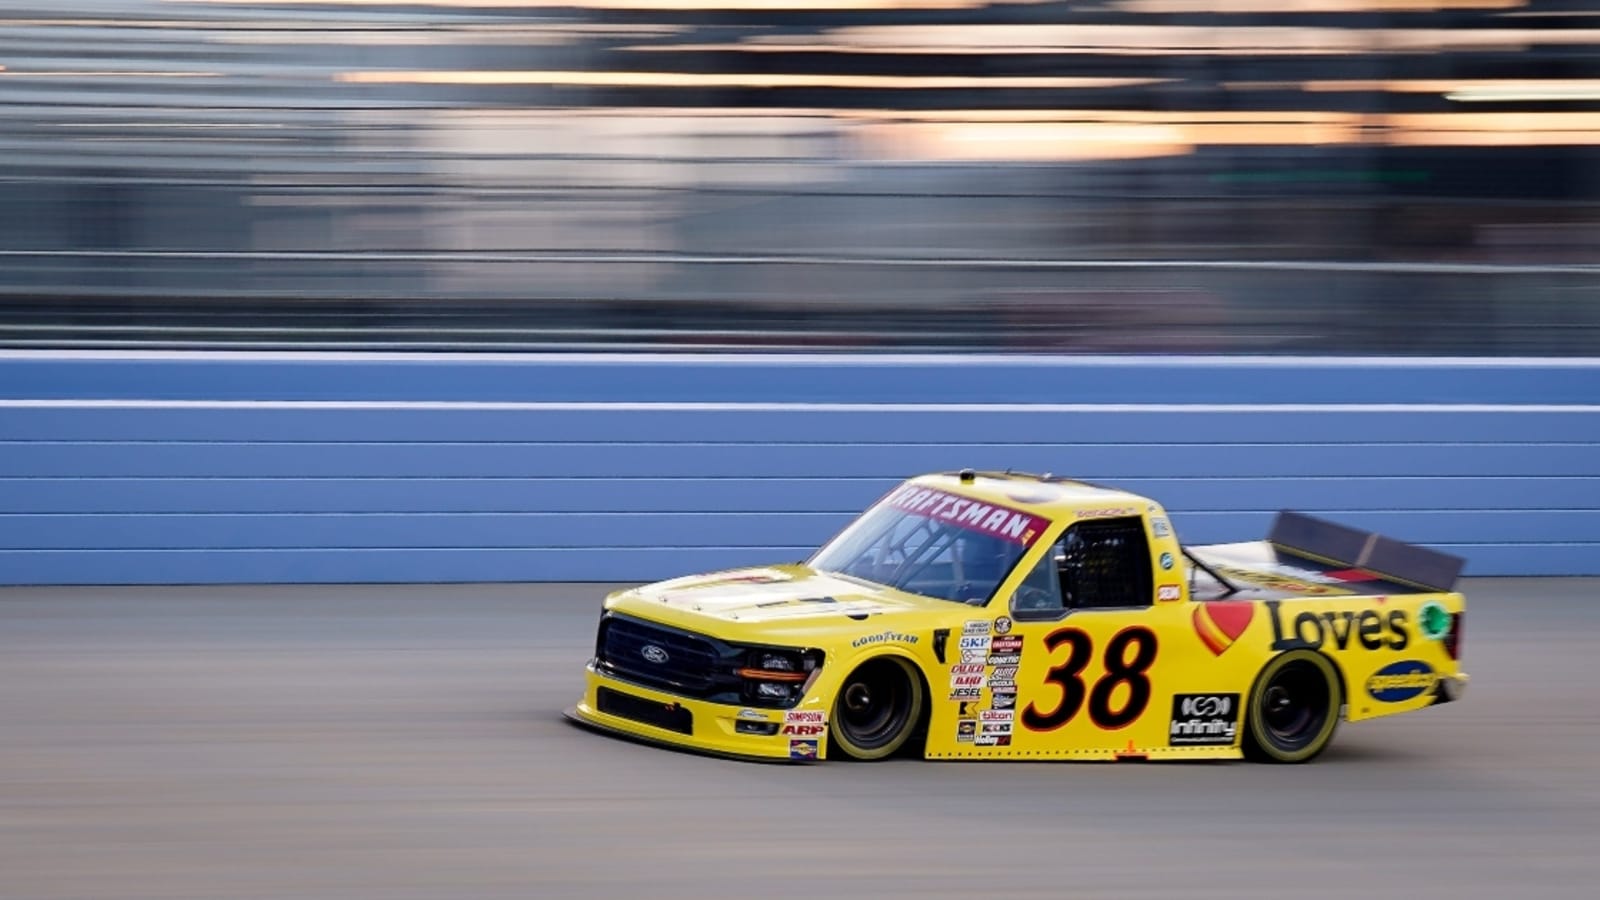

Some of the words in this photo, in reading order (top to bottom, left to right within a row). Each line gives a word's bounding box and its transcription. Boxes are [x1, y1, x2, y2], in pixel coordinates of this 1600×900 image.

[889, 486, 1032, 538] RAFTSMAN
[852, 632, 919, 648] GOODYEAR
[960, 637, 990, 648] SKF
[1020, 625, 1159, 733] 38
[950, 688, 981, 697] JESEL
[787, 712, 823, 722] SIMPSON
[982, 711, 1012, 720] tilton
[782, 725, 824, 736] ARP
[1170, 719, 1238, 736] Infinity
